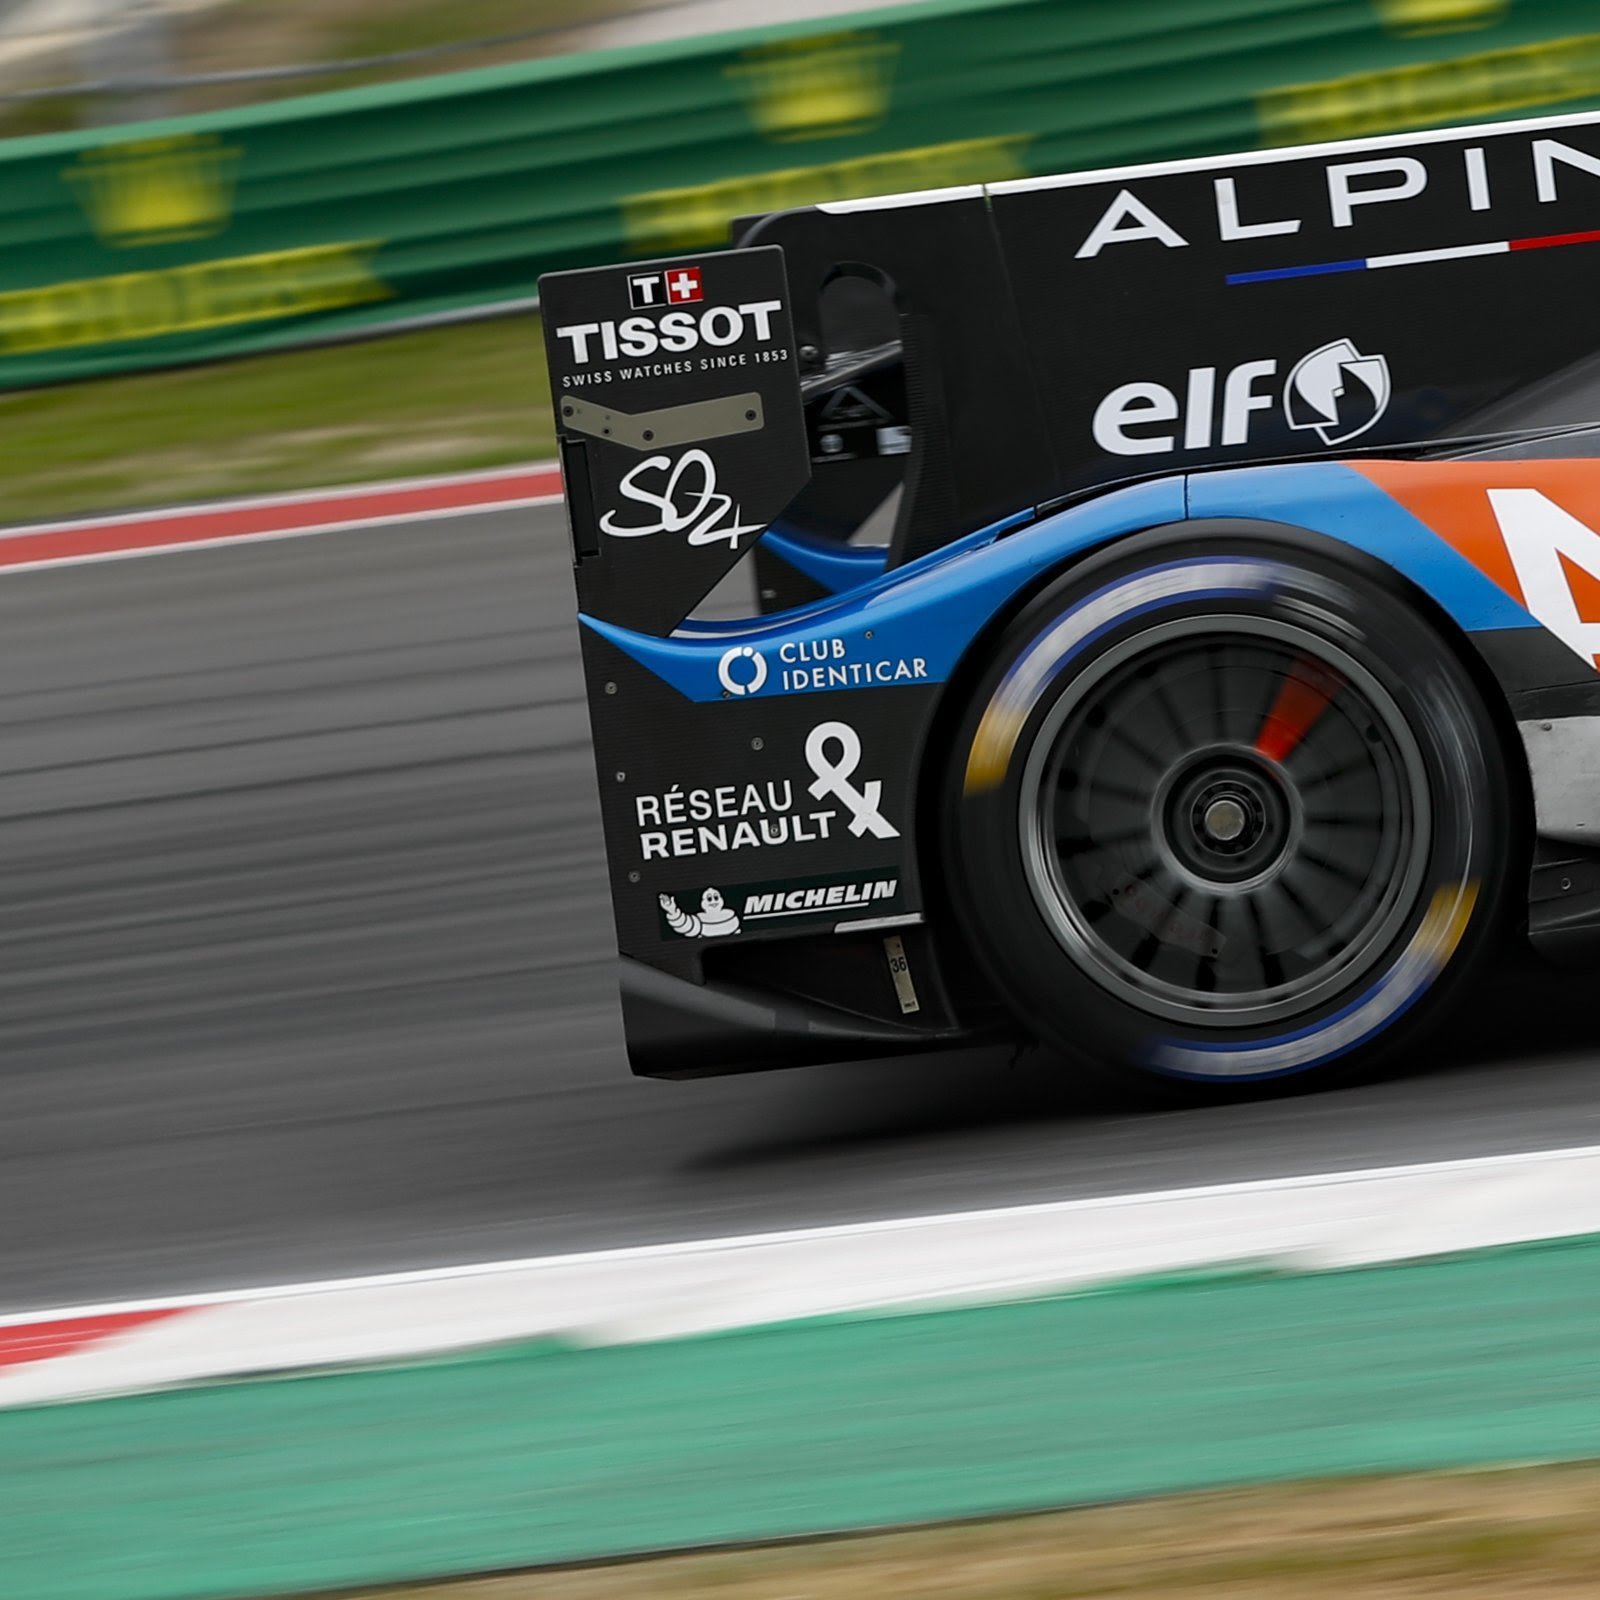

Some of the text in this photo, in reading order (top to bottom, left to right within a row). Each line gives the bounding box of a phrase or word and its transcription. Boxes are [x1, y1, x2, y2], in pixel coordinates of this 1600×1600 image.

[556, 300, 782, 364] TISSOT
[562, 349, 788, 388] SWISS WATCHES SINCE 1853
[1092, 359, 1276, 456] elf
[779, 638, 846, 663] CLUB
[783, 657, 928, 690] IDENTICAR
[636, 779, 793, 827] RÉSEAU
[640, 810, 836, 860] RENAULT
[743, 880, 898, 914] MICHELIN
[890, 956, 907, 973] 36
